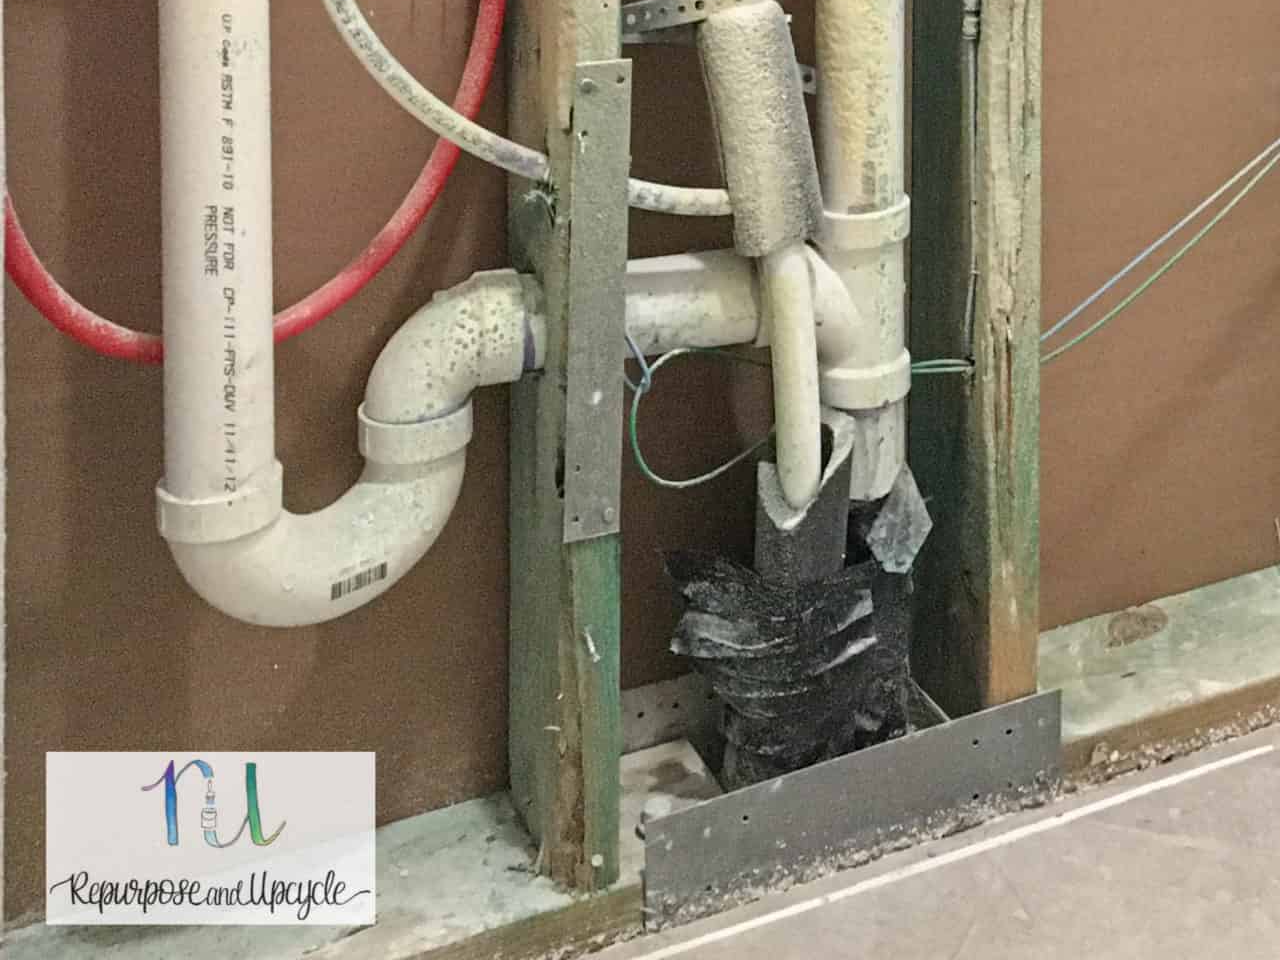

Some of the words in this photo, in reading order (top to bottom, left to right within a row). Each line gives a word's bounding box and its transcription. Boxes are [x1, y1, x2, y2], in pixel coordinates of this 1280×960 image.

[221, 74, 234, 111] ASTM
[221, 118, 234, 129] F
[221, 206, 236, 234] NOT
[203, 205, 219, 278] PRESSURE
[221, 243, 236, 271] FOR
